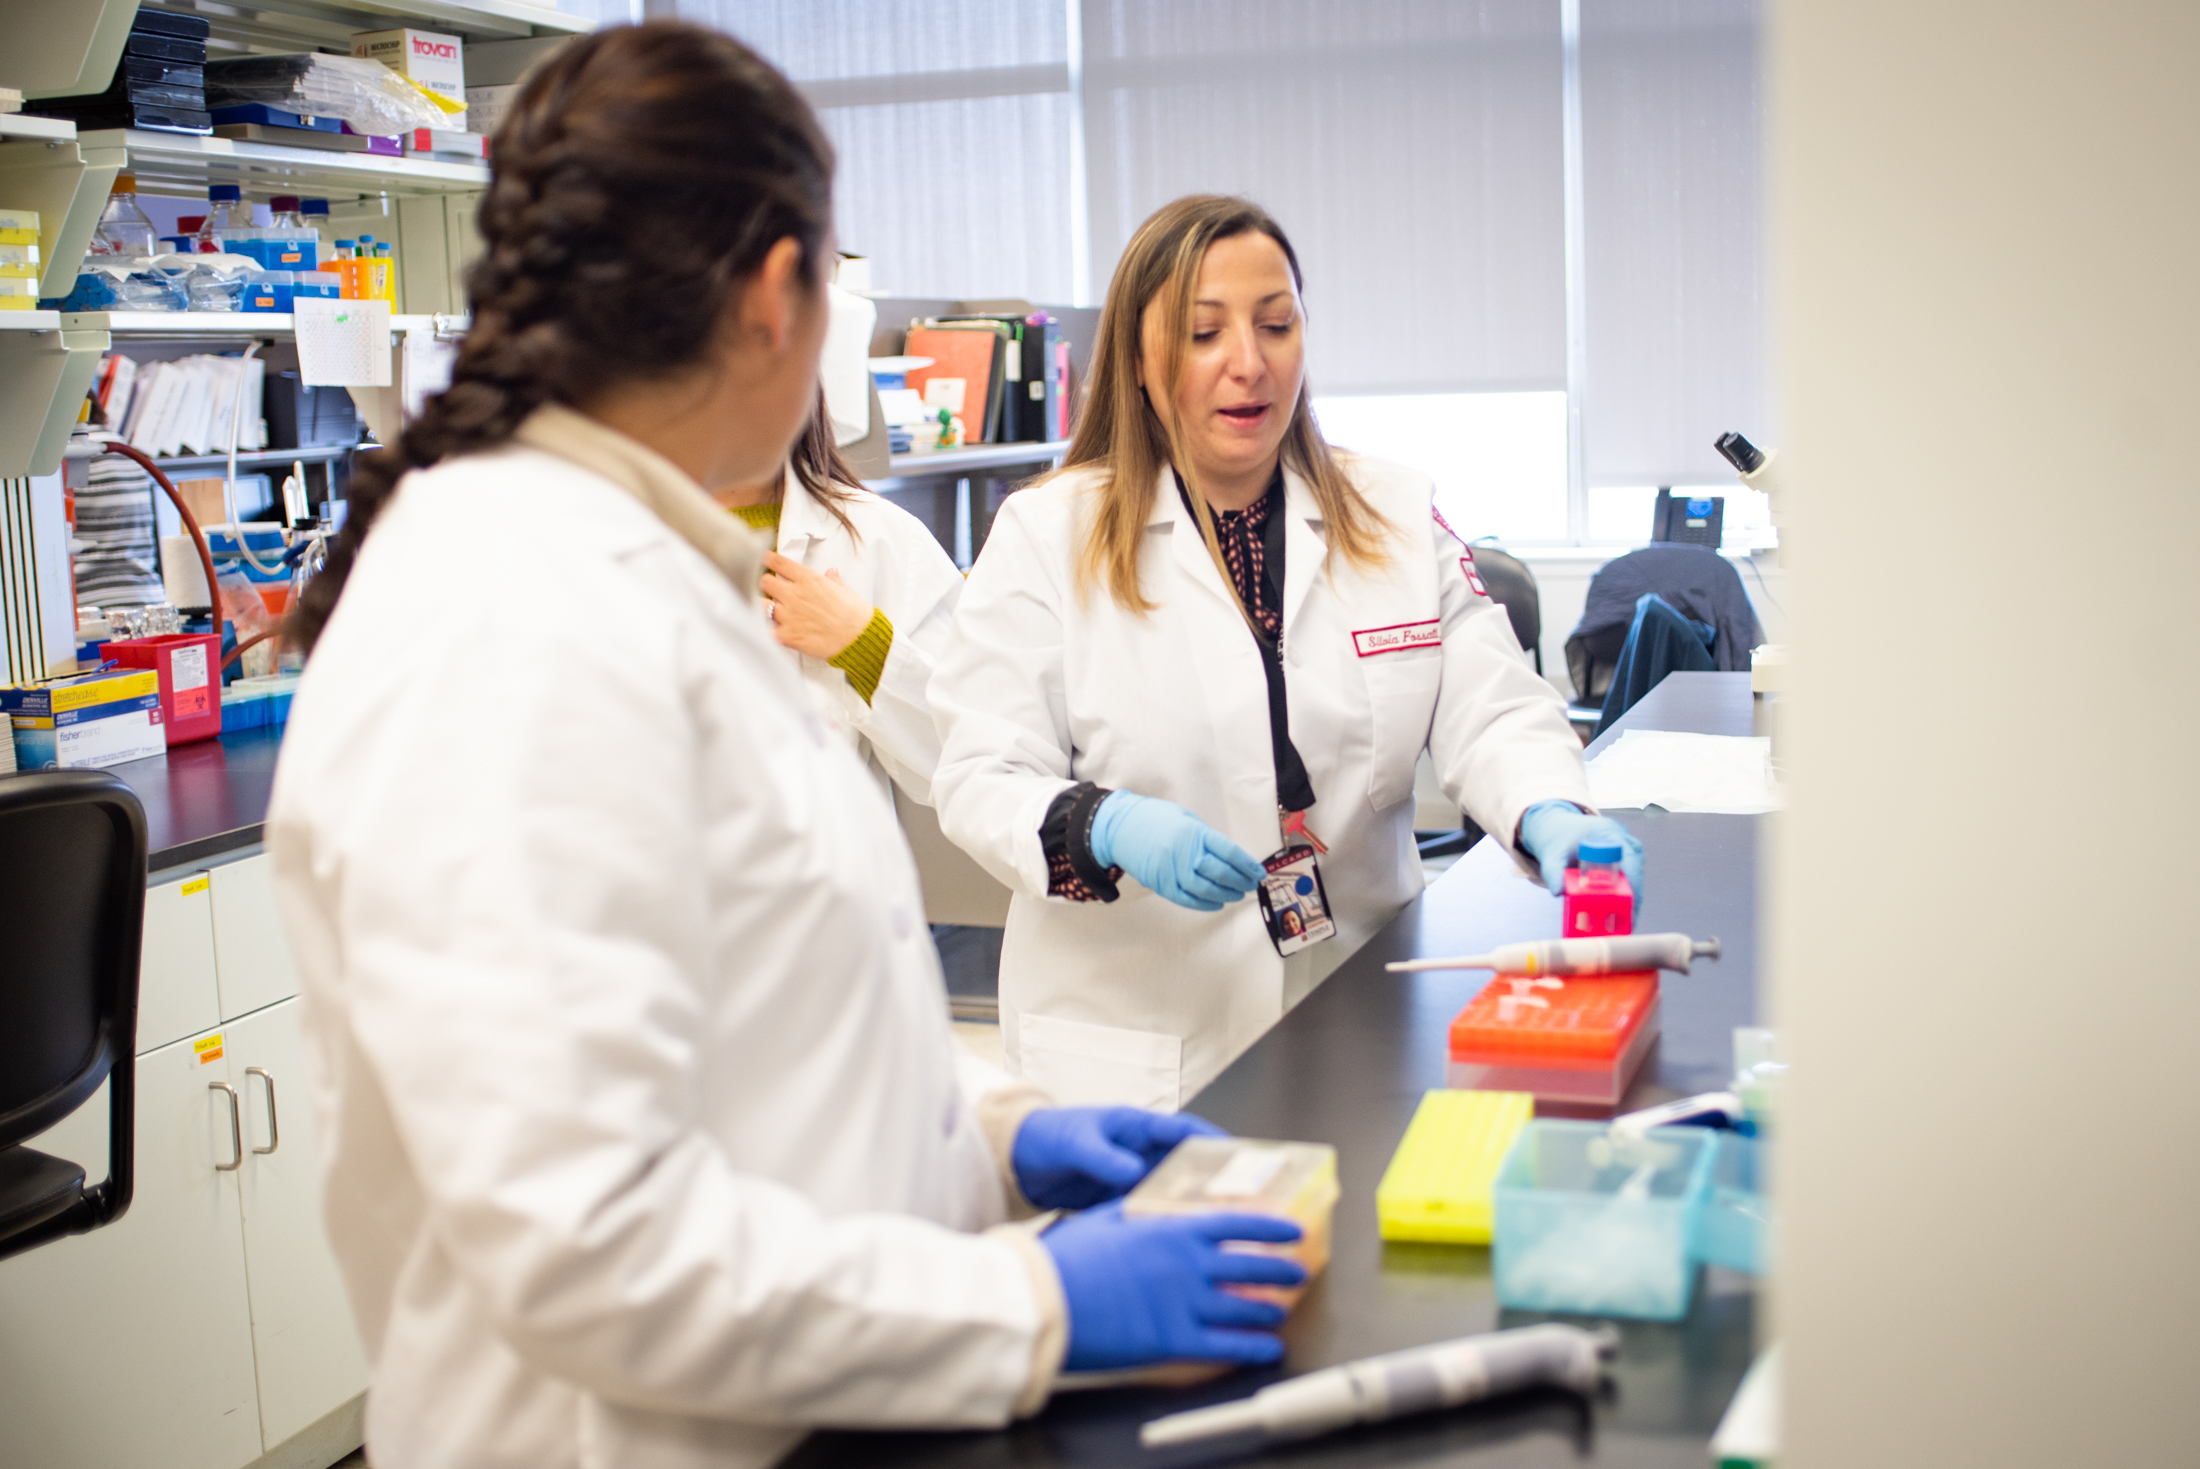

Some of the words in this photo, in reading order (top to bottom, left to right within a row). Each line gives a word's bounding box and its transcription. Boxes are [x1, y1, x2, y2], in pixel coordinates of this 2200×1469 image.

[412, 36, 457, 59] trovan
[1368, 634, 1399, 648] Silvia
[1267, 850, 1310, 872] WLCARD
